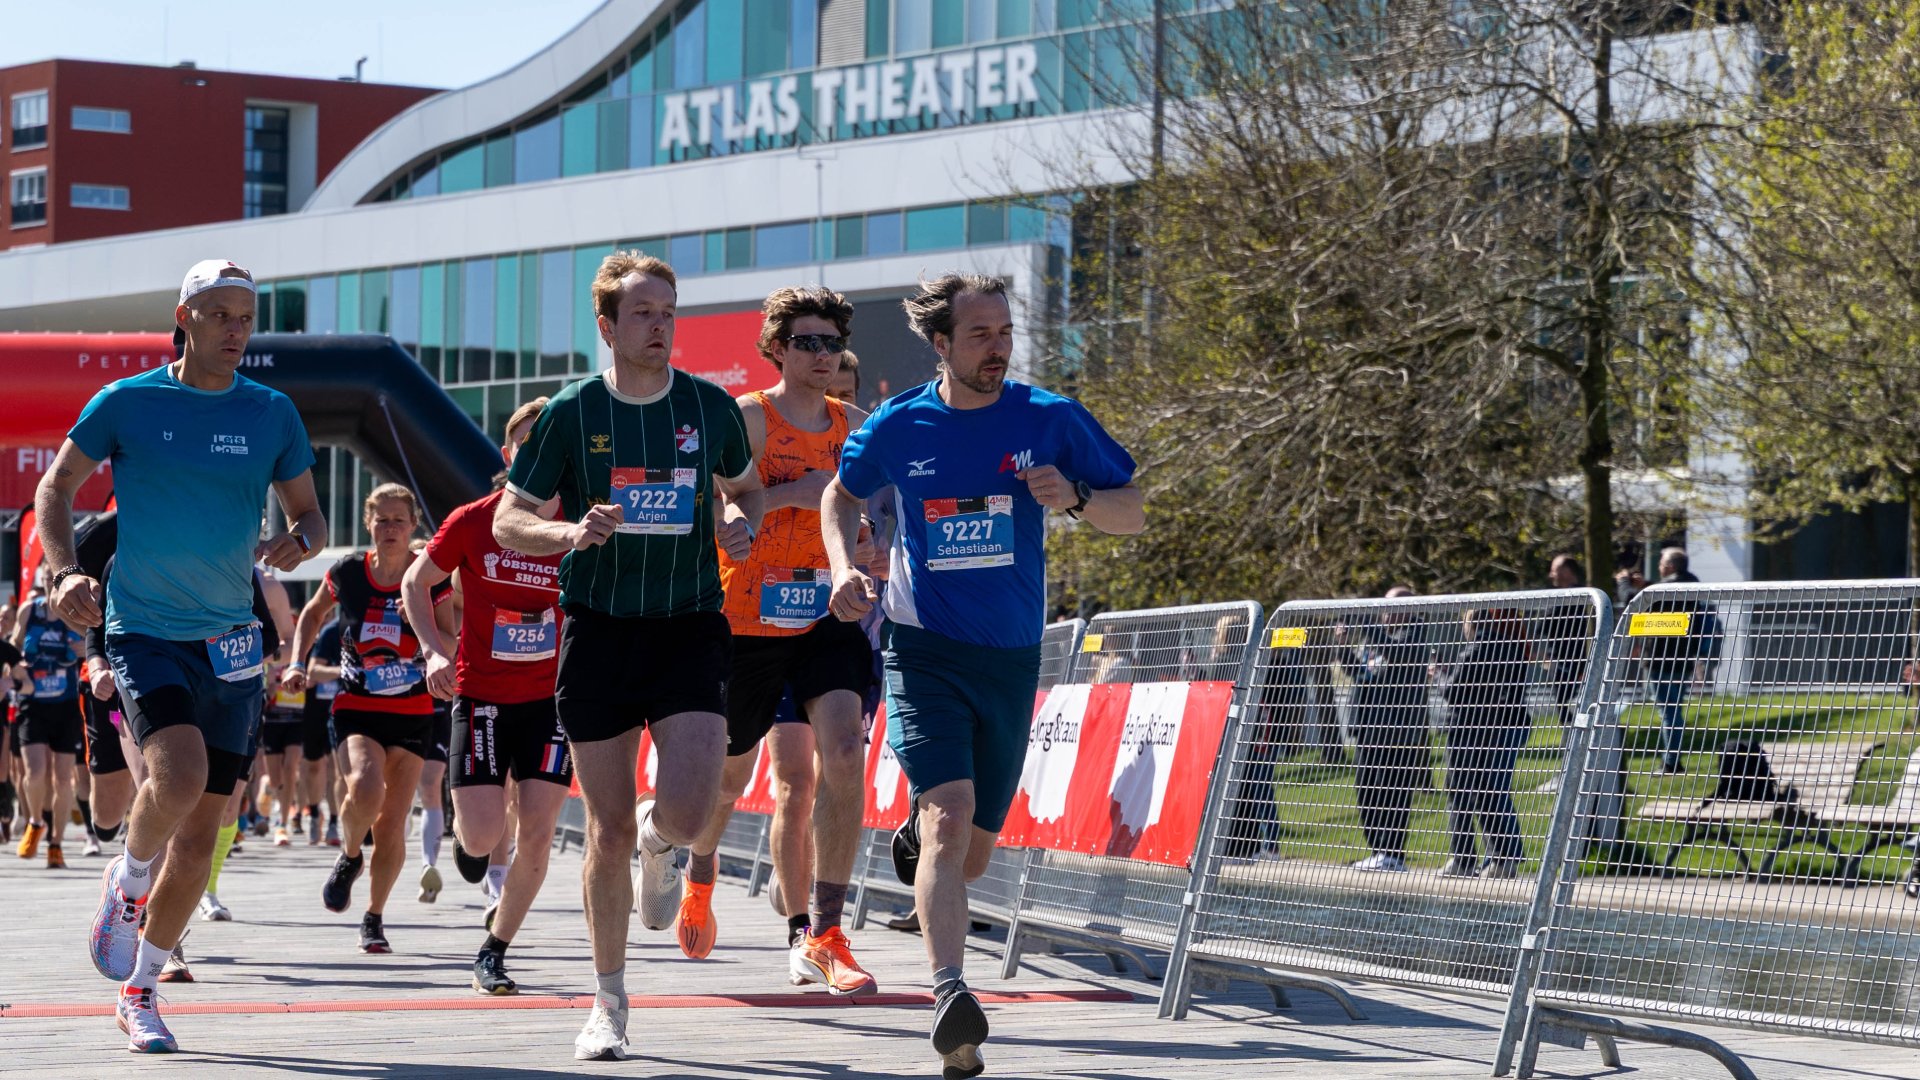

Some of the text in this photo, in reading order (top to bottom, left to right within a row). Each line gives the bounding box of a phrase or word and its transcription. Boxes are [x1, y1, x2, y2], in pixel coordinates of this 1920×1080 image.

[659, 43, 1039, 149] ATLAS THEATER
[78, 353, 170, 369] PETER
[629, 489, 678, 509] 9222
[637, 511, 667, 523] Arjen
[942, 519, 994, 542] 9227
[937, 542, 1002, 556] Sebastiaan
[501, 559, 560, 576] OBSTACL
[515, 572, 551, 586] SHOP
[779, 586, 816, 605] 9313
[774, 605, 817, 617] Tommaso
[507, 627, 546, 643] 9256
[220, 634, 253, 659] 9259
[515, 643, 537, 652] Leon
[230, 655, 250, 669] Mark
[386, 679, 405, 688] Hilde
[474, 729, 484, 761] SHOP
[486, 720, 498, 776] OBSTACLE
